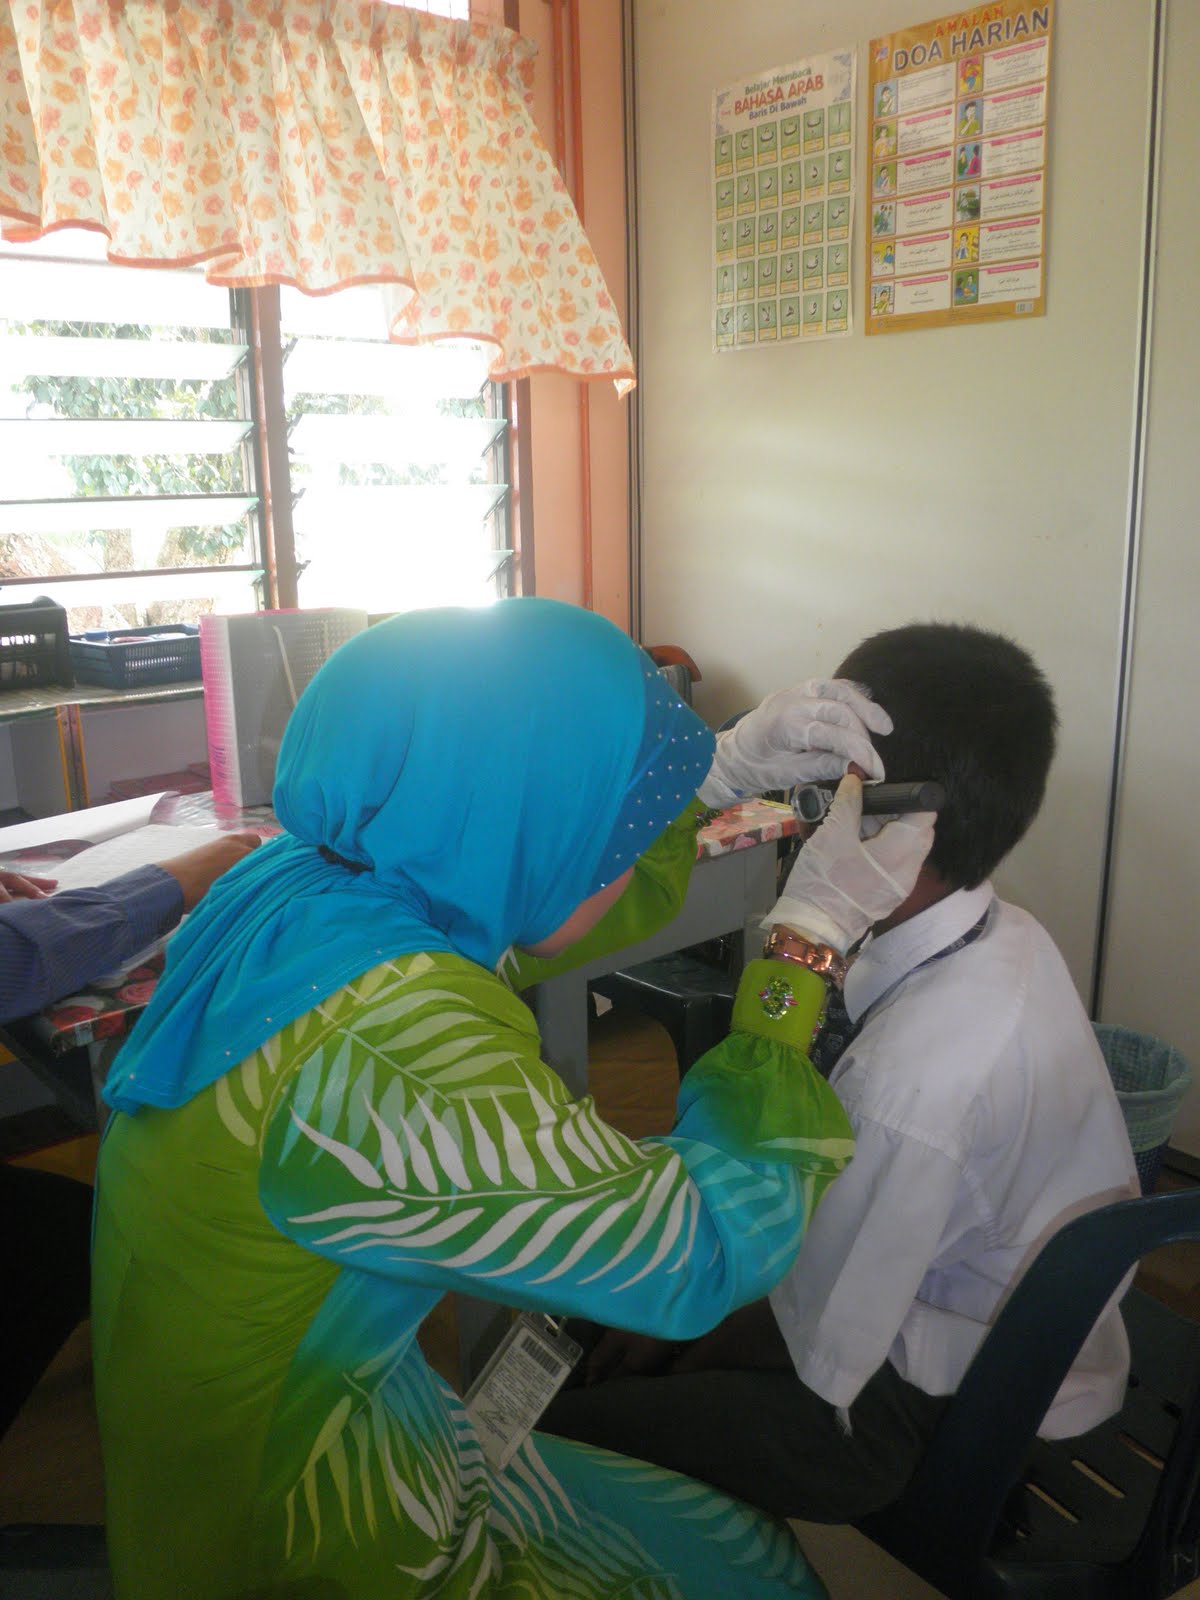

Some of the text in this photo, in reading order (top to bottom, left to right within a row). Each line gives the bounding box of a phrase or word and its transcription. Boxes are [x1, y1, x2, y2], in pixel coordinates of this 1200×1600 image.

[936, 6, 1004, 37] AMALAN
[894, 40, 942, 71] DOA
[952, 7, 1049, 55] HARIAN
[735, 75, 824, 115] BAHASA ARAB
[745, 67, 812, 95] Belajar Membaca
[749, 96, 807, 120] Baris Di Bawah
